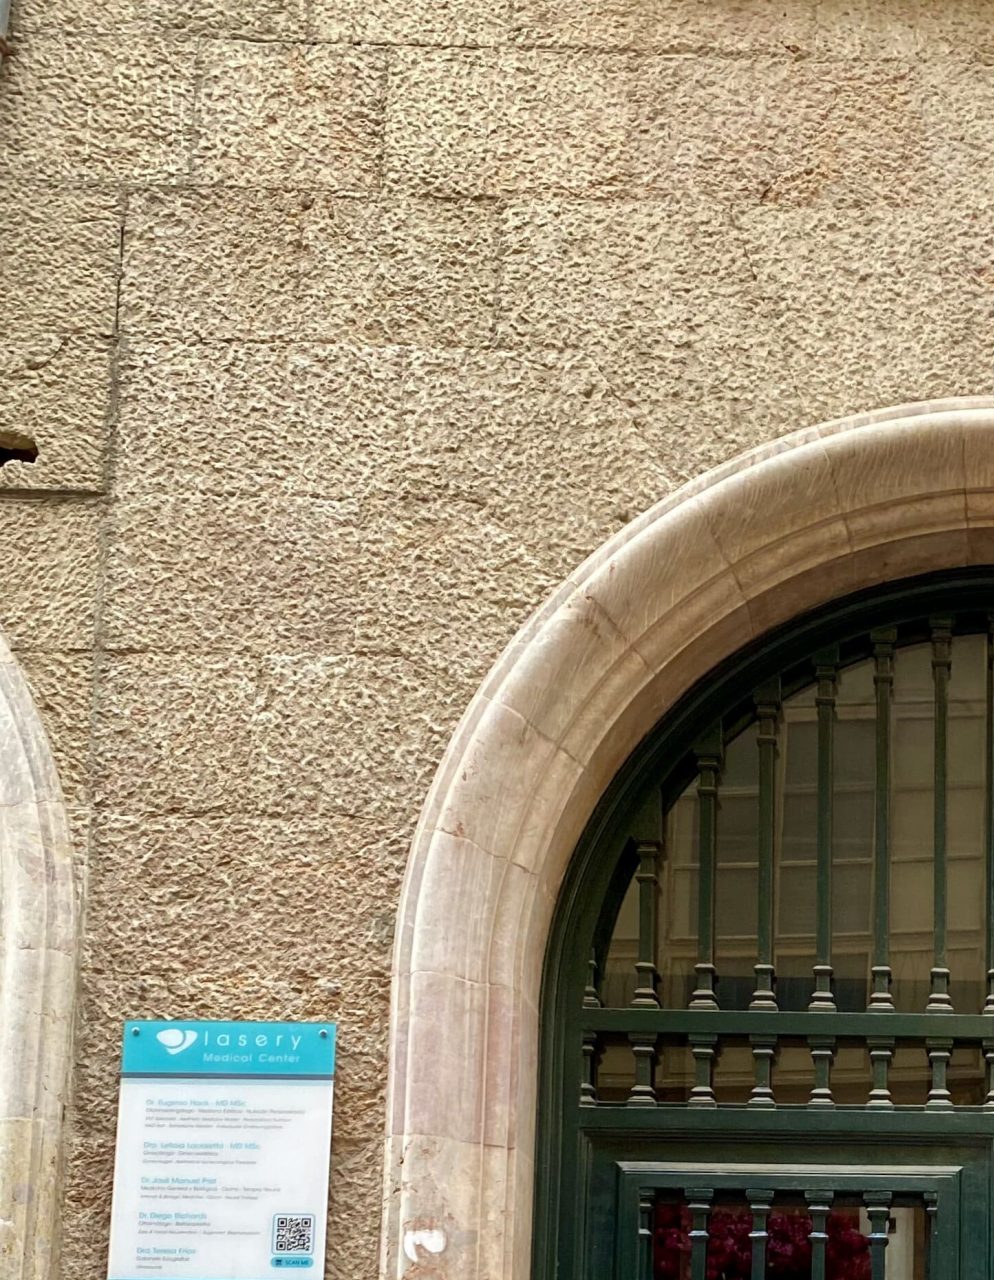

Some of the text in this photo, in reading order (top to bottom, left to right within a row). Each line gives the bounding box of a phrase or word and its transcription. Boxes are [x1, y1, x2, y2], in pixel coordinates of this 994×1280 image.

[204, 1030, 302, 1050] lasery
[203, 1053, 300, 1064] Medical Center
